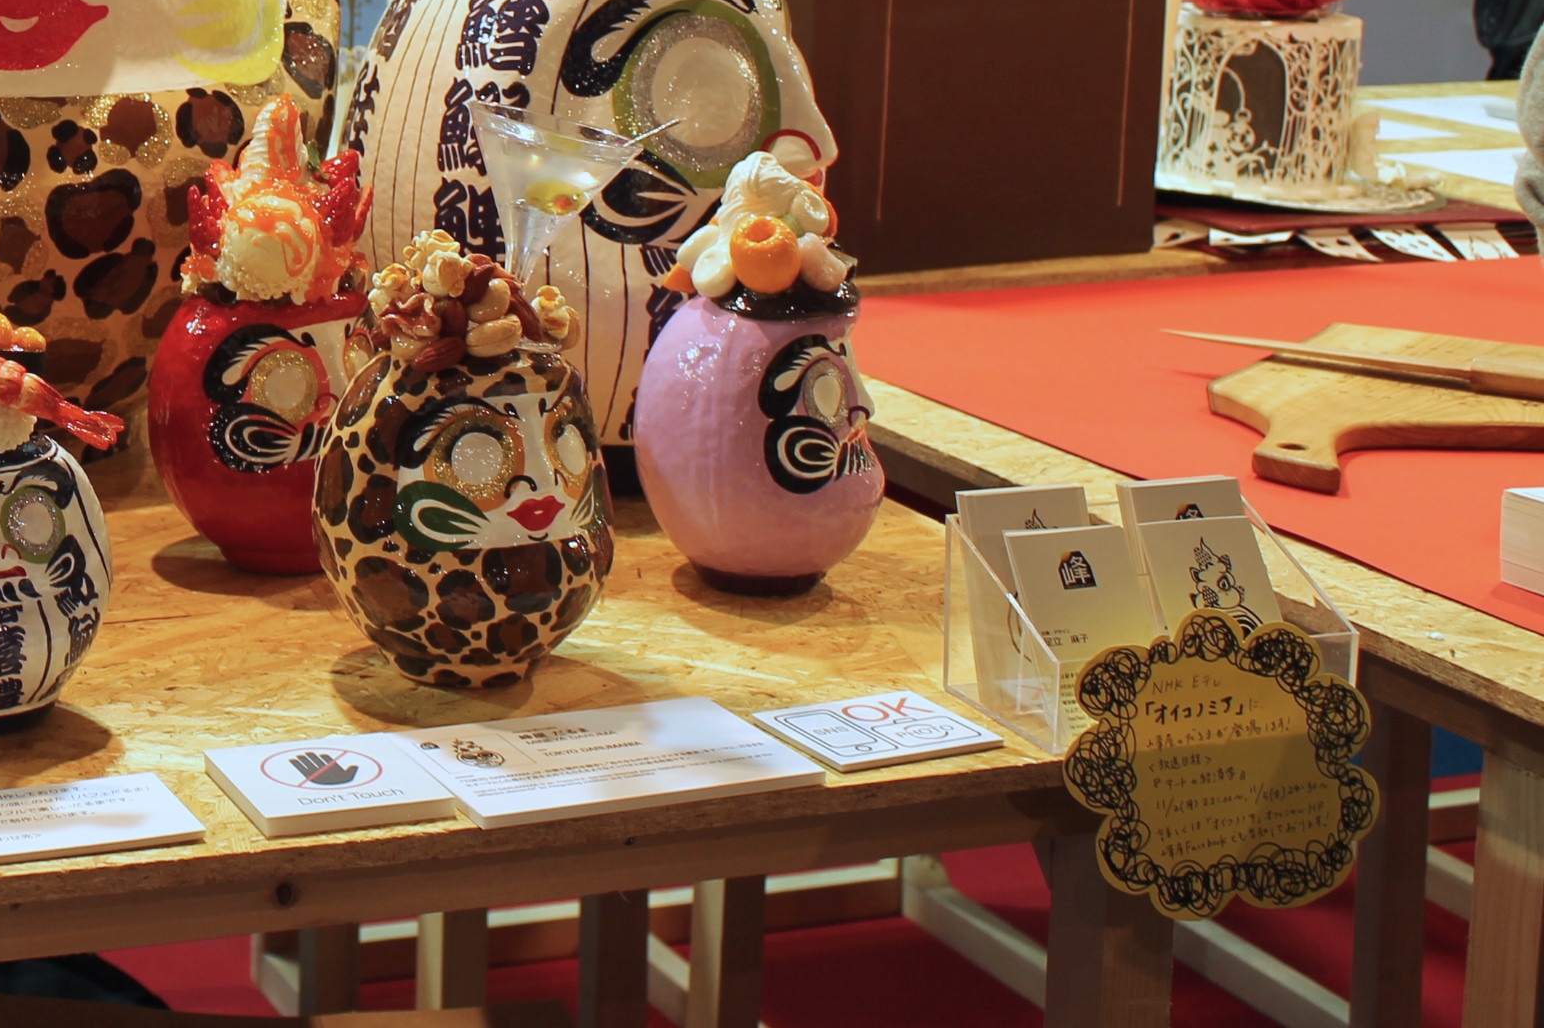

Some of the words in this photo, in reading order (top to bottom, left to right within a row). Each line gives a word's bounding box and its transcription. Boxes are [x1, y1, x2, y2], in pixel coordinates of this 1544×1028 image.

[1061, 556, 1091, 586] 峰
[1152, 678, 1184, 694] NHK
[841, 691, 937, 722] OK
[811, 724, 850, 737] SNS
[894, 722, 955, 741] PHOTO
[297, 791, 347, 806] Don't
[348, 786, 405, 801] Touch
